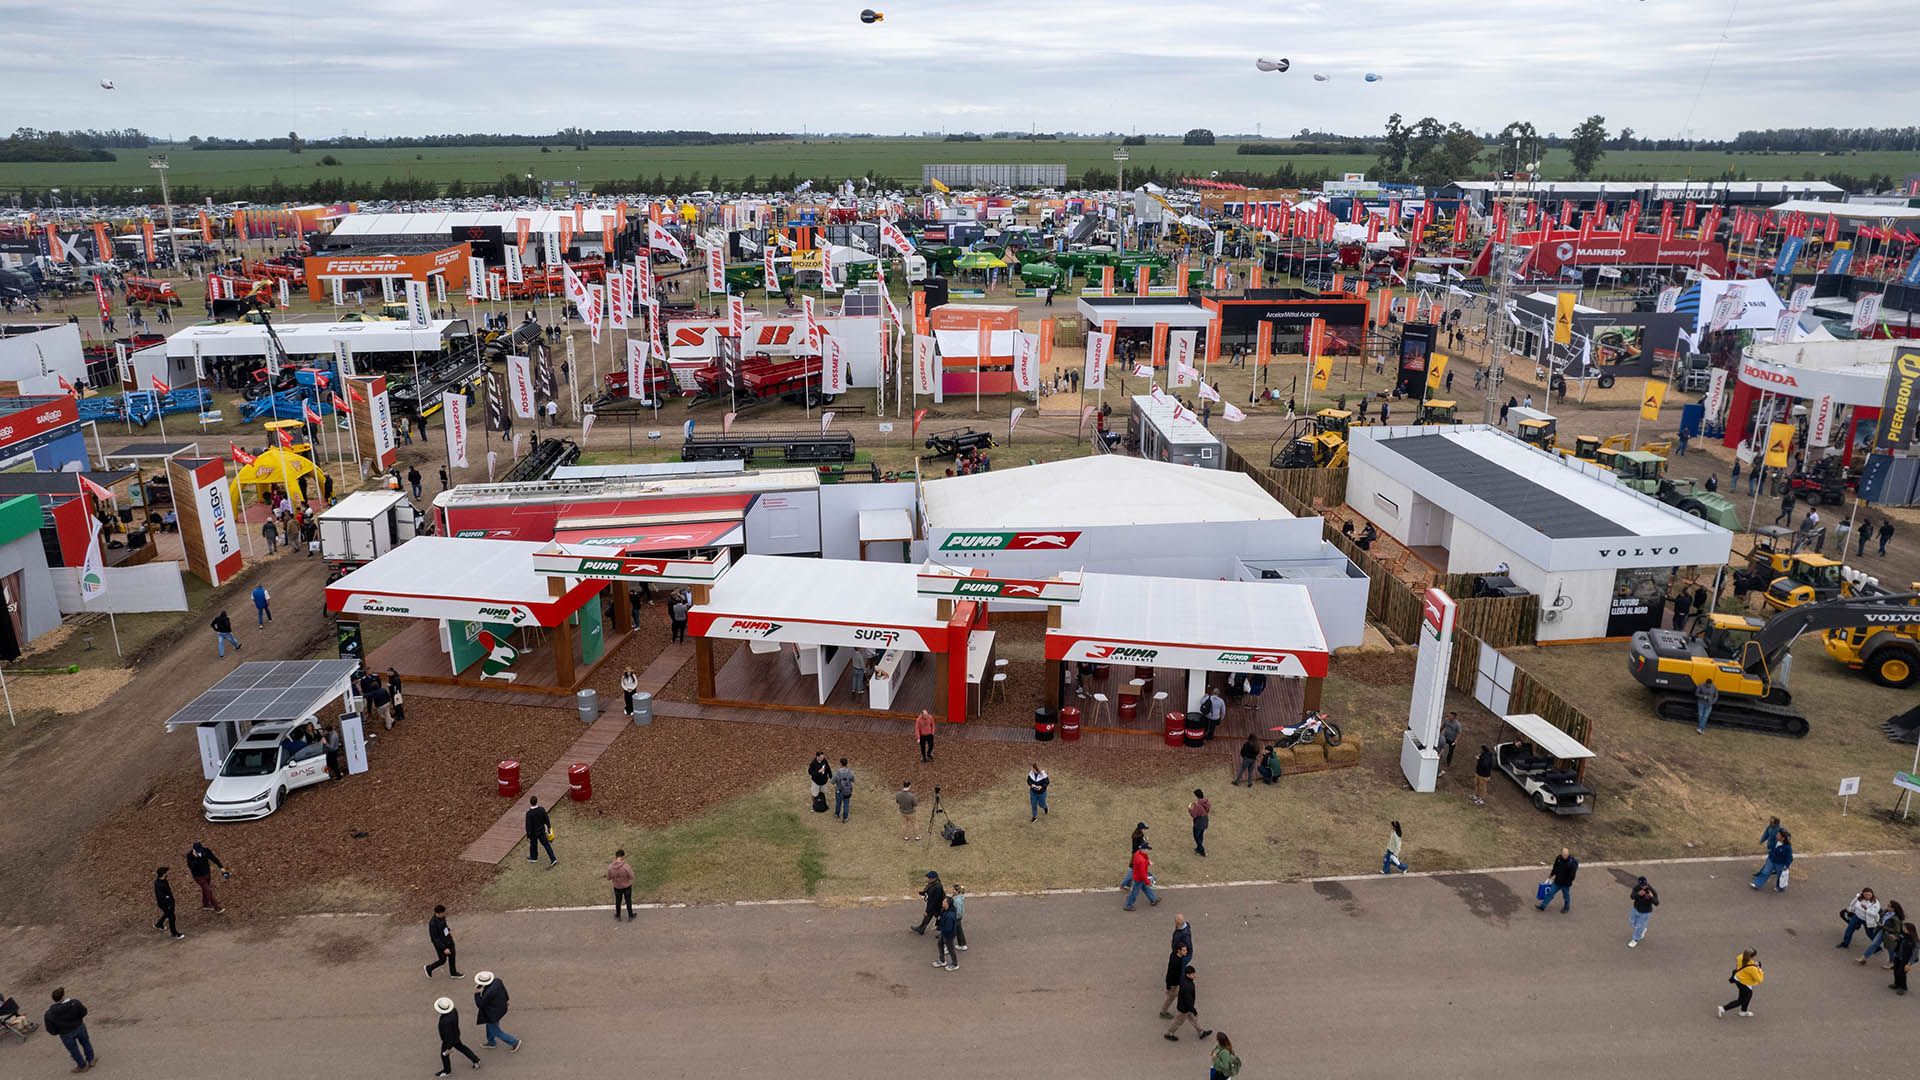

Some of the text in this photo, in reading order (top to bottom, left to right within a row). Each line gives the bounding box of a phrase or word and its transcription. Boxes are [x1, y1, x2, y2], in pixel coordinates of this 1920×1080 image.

[1661, 190, 1717, 199] NEW HOLLAD
[1576, 248, 1627, 257] MAINERO
[326, 260, 398, 273] FERCAM
[712, 250, 723, 290] SYRA
[611, 278, 623, 325] SYRA
[920, 355, 929, 392] ROSSMET
[1021, 351, 1029, 387] ROSSMET
[1743, 364, 1799, 388] HONDA
[518, 376, 530, 414] ROSSMET
[1887, 377, 1915, 442] PIEROBON
[1815, 394, 1831, 441] HONDA
[584, 535, 637, 546] PUMA
[947, 536, 1003, 547] PUMA
[1599, 546, 1680, 558] VOLVO
[583, 560, 620, 571] PUMA
[959, 583, 999, 593] PUMA
[1619, 598, 1640, 606] FUTURO
[363, 604, 410, 614] SOLAR POWER
[478, 607, 511, 616] PUMA
[1864, 614, 1920, 622] VOLVO
[731, 620, 771, 631] PUMA
[1112, 646, 1159, 658] PUMA
[1220, 653, 1250, 661] PUMA
